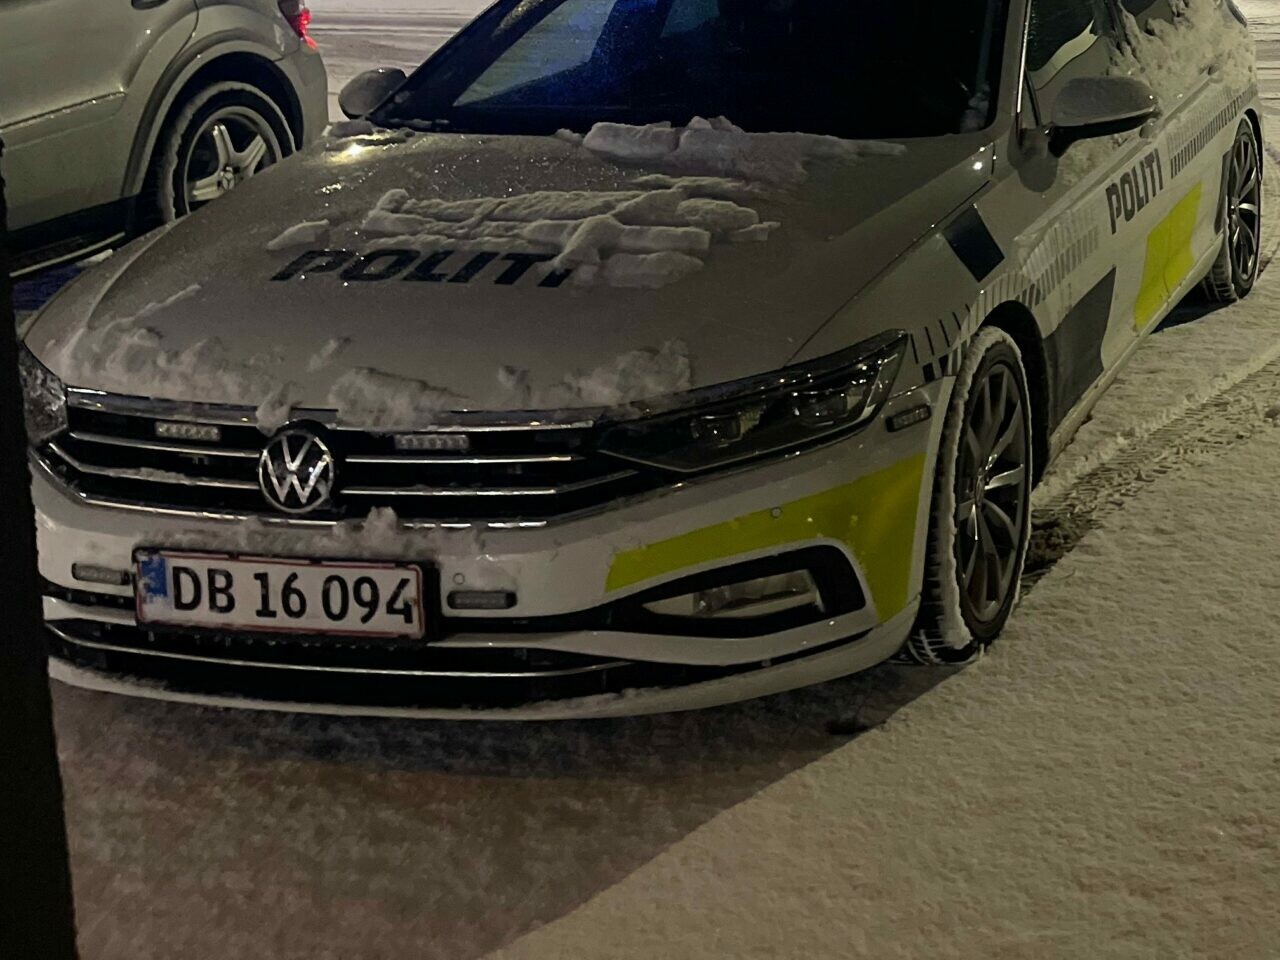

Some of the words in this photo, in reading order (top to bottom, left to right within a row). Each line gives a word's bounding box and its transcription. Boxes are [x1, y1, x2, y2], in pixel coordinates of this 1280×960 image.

[1105, 147, 1164, 235] POLITI
[171, 566, 236, 614] DB
[253, 572, 307, 619] 16
[321, 574, 414, 625] 094
